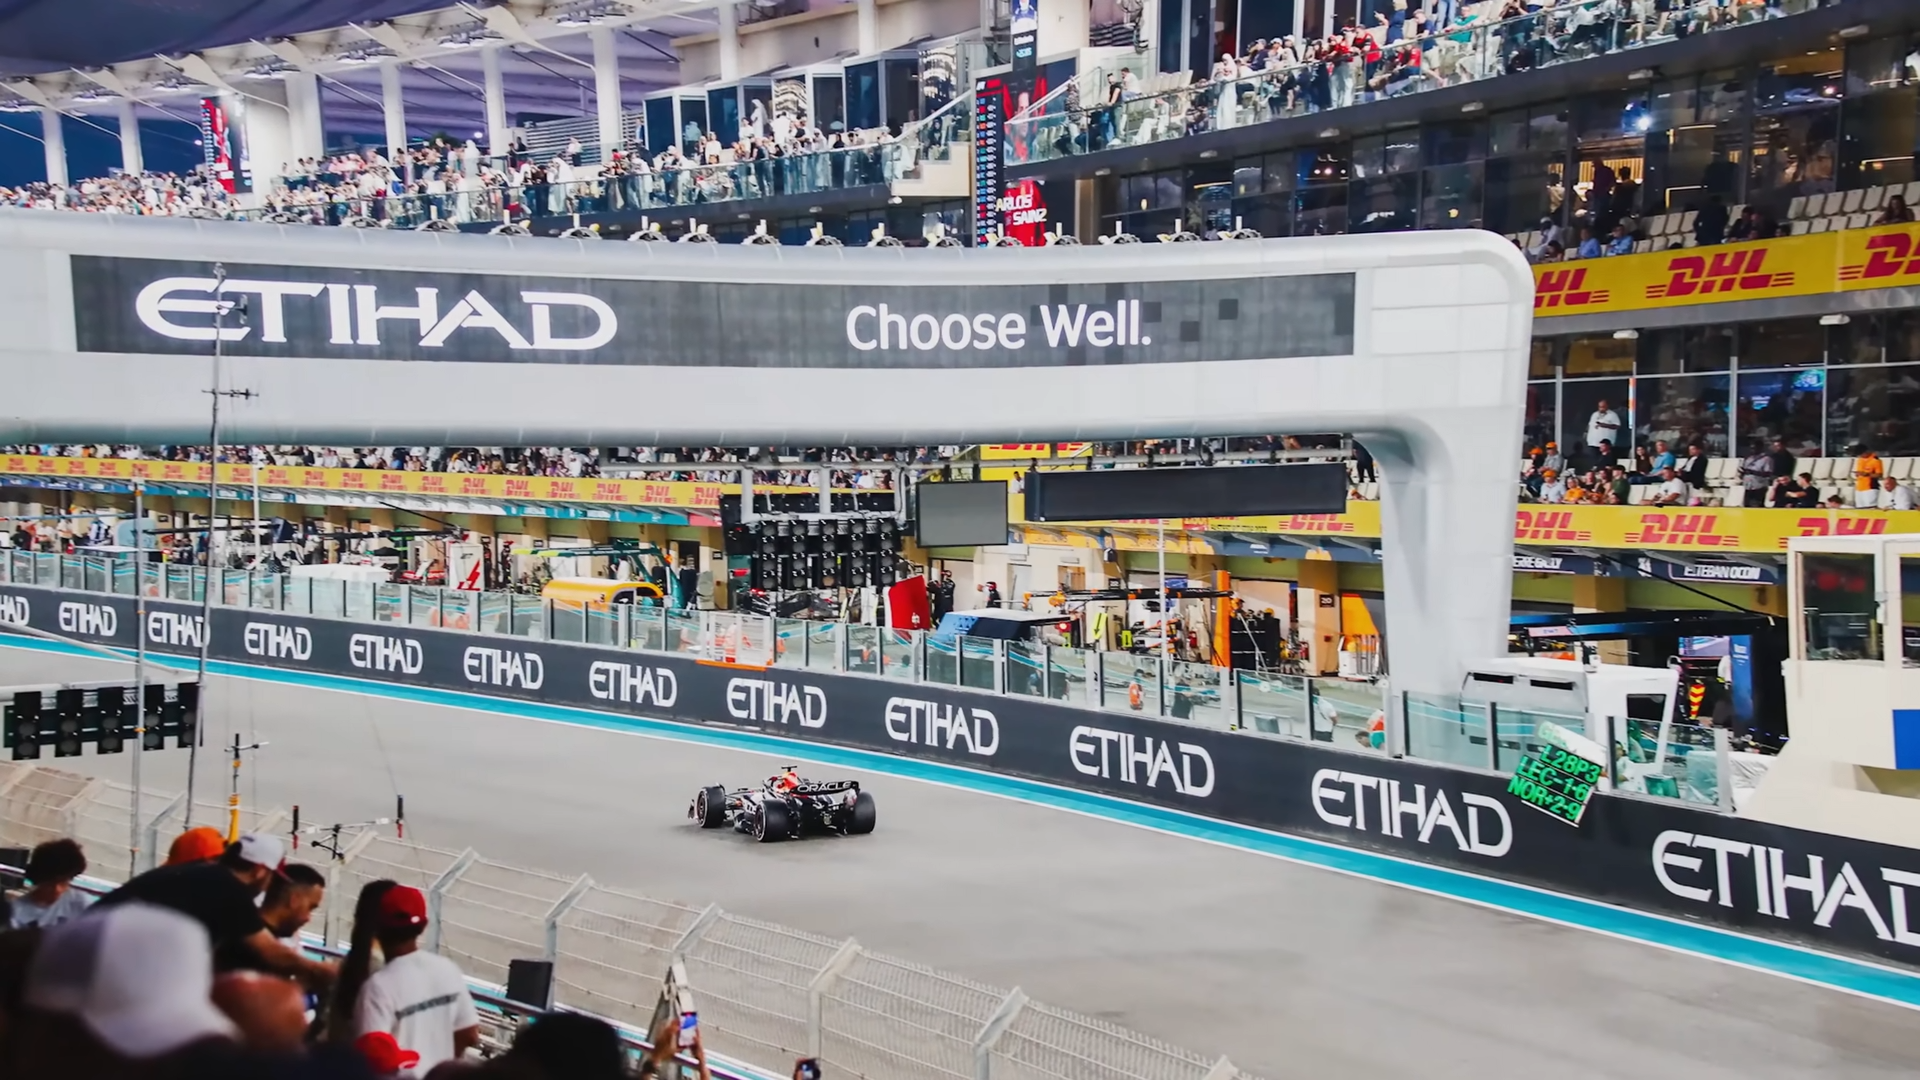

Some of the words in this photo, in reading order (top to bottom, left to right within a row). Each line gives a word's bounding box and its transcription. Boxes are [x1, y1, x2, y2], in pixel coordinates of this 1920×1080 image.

[995, 194, 1033, 212] ARLOS
[1013, 208, 1047, 226] SAINZ
[1535, 268, 1592, 308] HL
[1666, 249, 1772, 297] DHL
[136, 276, 618, 351] ETIHAD
[846, 303, 1027, 351] Choose
[1040, 299, 1152, 347] Well.
[1515, 511, 1577, 540] DHL
[1639, 514, 1722, 545] DHL
[0, 594, 30, 626] HAD
[59, 601, 117, 637] ETIHAD
[147, 611, 211, 647] ETIHAD
[244, 621, 312, 661] ETIHAD
[350, 633, 423, 674] ETIHAD
[464, 646, 544, 690] ETIHAD
[589, 660, 678, 708] ETIHAD
[726, 678, 827, 728] ETIHAD
[885, 696, 1000, 756] ETIHAD
[1069, 725, 1215, 797] ETIHAD
[798, 781, 851, 793] ORACLE
[1311, 768, 1513, 857] ETIHAD
